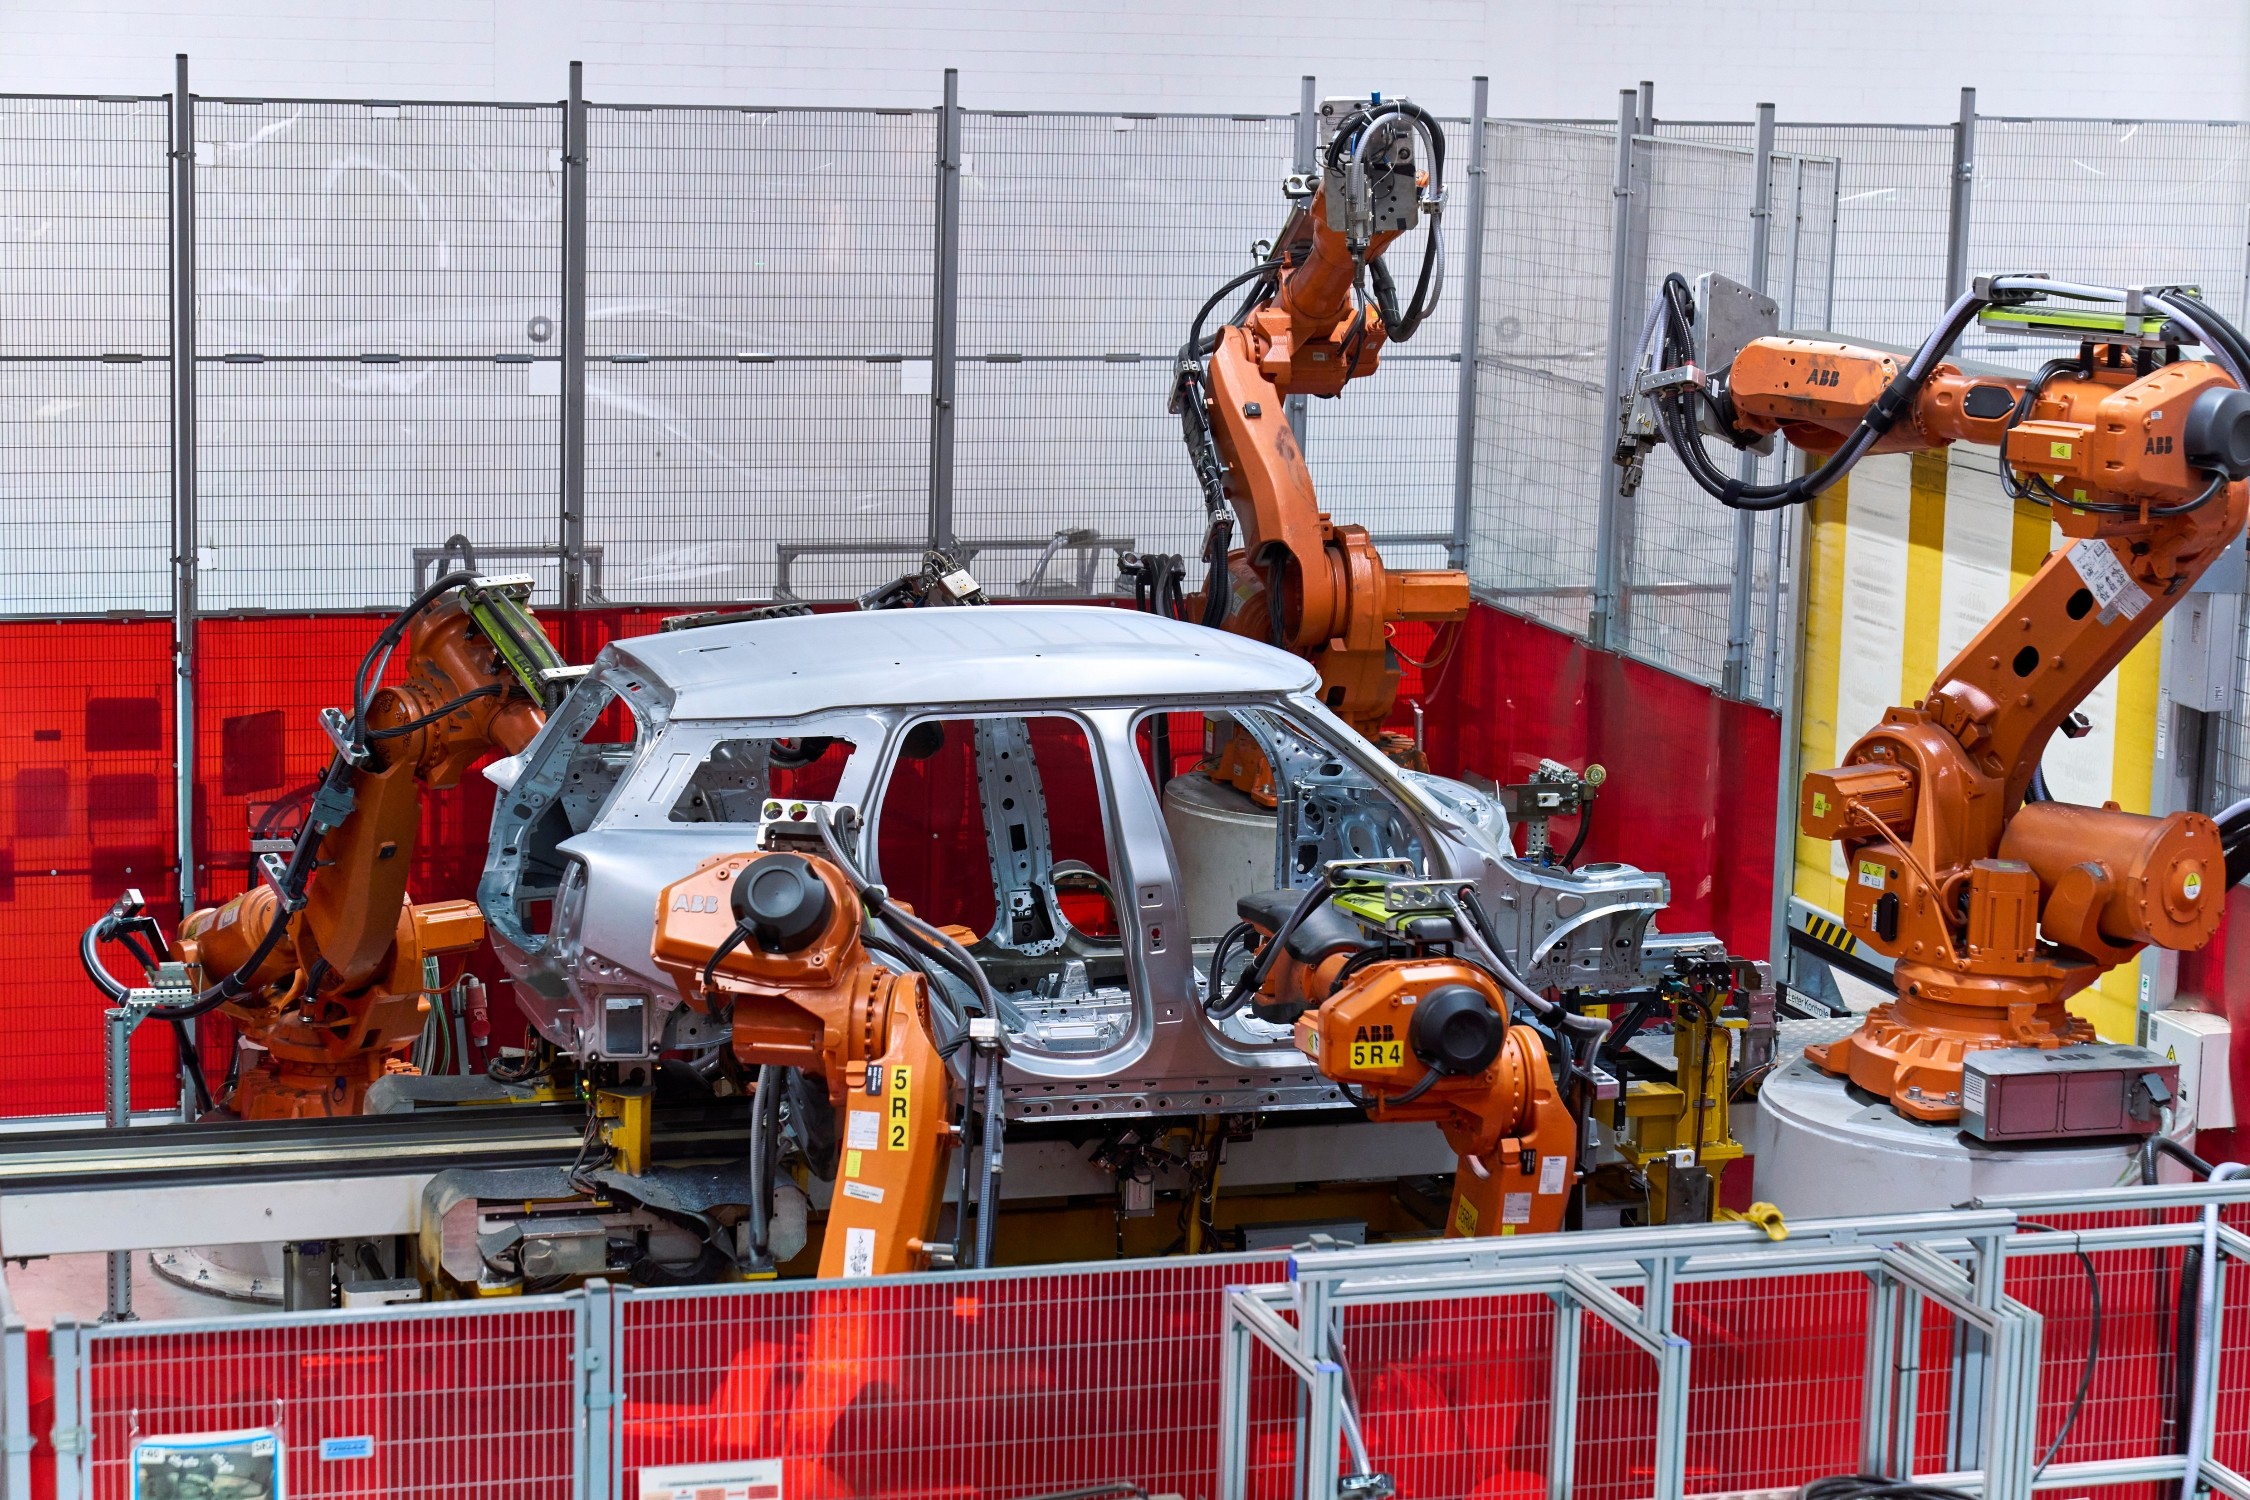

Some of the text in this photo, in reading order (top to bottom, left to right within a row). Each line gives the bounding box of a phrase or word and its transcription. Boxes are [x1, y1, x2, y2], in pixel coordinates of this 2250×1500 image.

[1806, 368, 1840, 387] ABB
[2144, 436, 2173, 455] ABB
[672, 894, 718, 914] ABB
[1354, 1024, 1394, 1043] ABB
